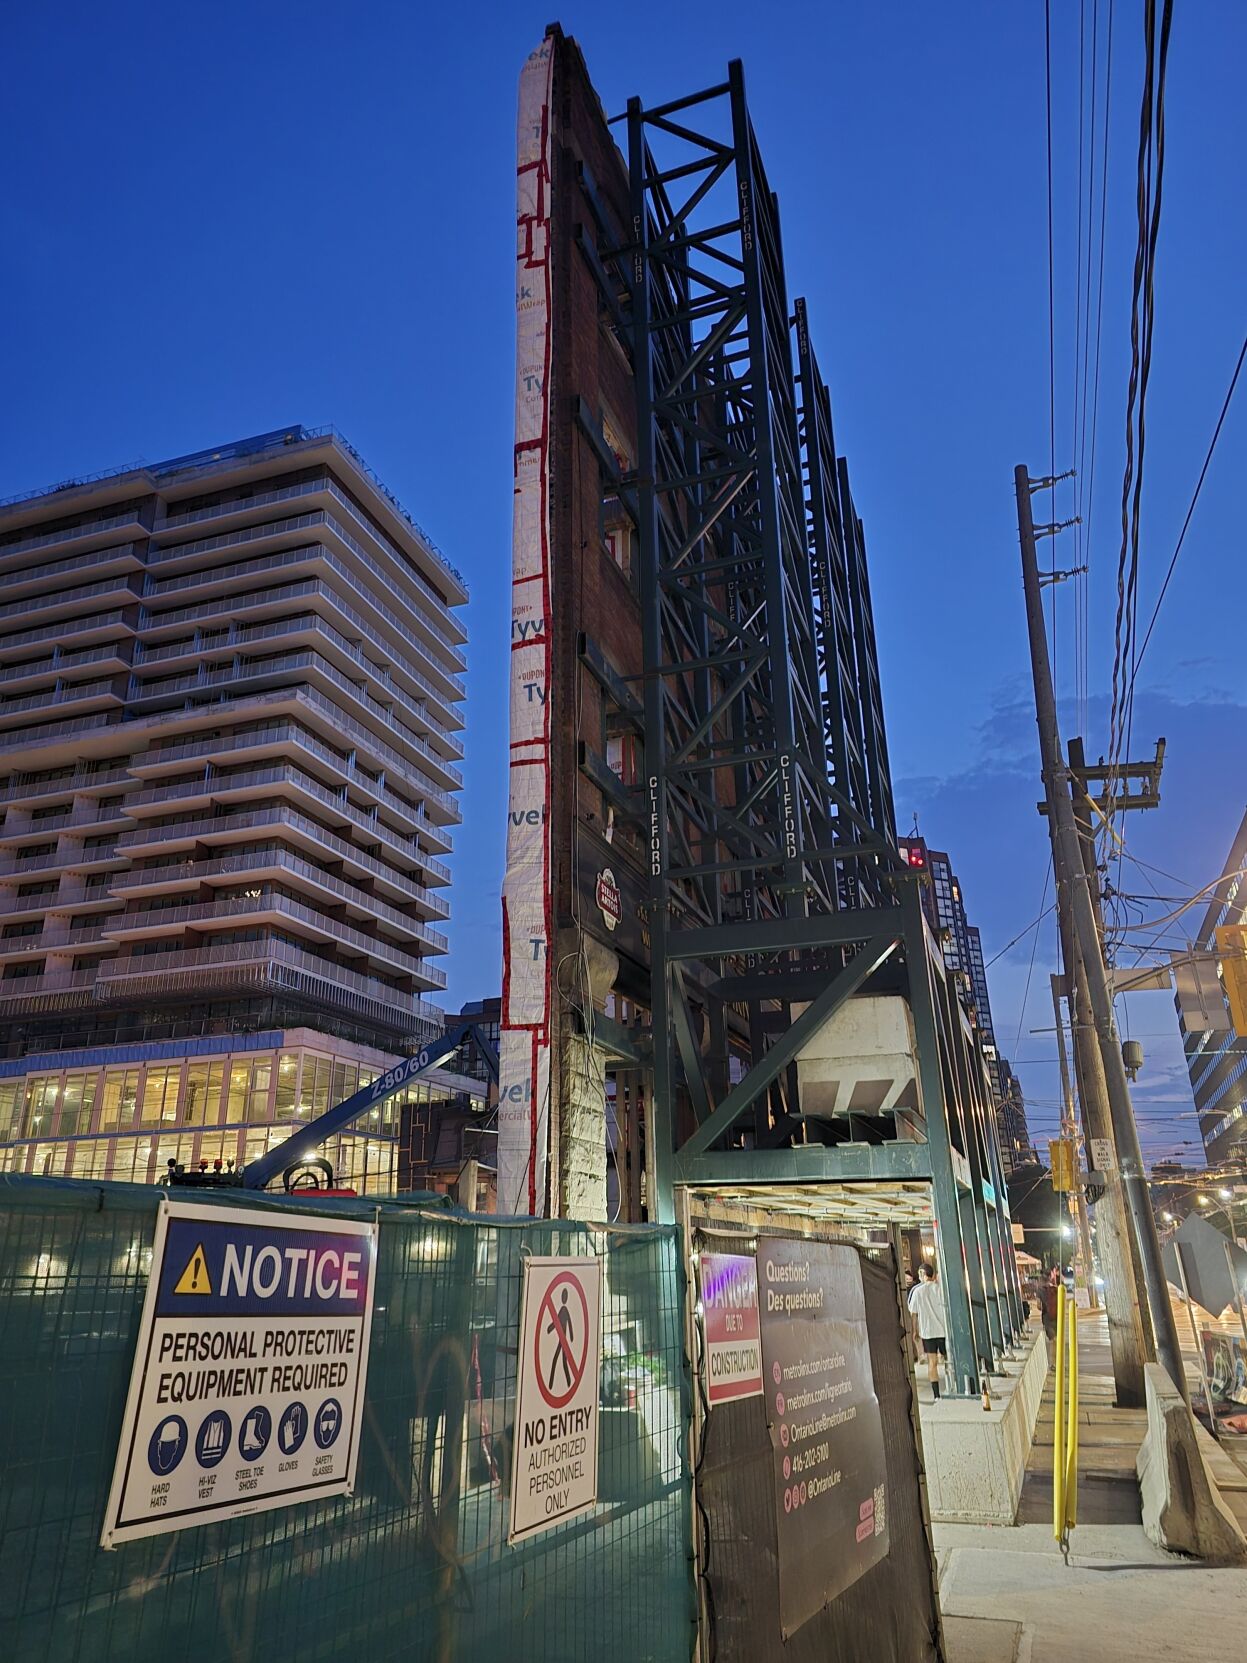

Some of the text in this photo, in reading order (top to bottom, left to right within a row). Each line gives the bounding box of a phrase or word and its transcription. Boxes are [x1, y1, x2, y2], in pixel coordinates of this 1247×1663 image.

[740, 181, 753, 250] CLIFFORD
[633, 215, 642, 283] CLIORD
[819, 561, 831, 628] CLIFFORD
[780, 754, 797, 859] CLIFFORD
[649, 776, 661, 876] CLIFFORD
[601, 882, 618, 904] STELLA
[370, 1051, 429, 1099] Z-80/60
[219, 1243, 362, 1300] NOTICE
[766, 1259, 810, 1283] Questions?
[767, 1287, 824, 1318] Des questions?
[725, 1313, 744, 1332] DUE TO
[158, 1328, 356, 1364] PERSONAL PROTECTIVE
[711, 1347, 759, 1377] CONSTRUCTION
[156, 1361, 349, 1405] EQUIPMENT REQUIRED
[524, 1405, 593, 1449] NO ENTRY
[278, 1460, 298, 1472] GLOVES
[315, 1454, 333, 1466] SAFETY
[528, 1437, 587, 1472] AUTHORIZED
[792, 1441, 829, 1473] 416-202-5100
[198, 1474, 217, 1487] HI-VIZ
[235, 1466, 264, 1481] STEEL TOE
[238, 1479, 258, 1491] SHOES
[312, 1465, 333, 1477] GLASSES
[529, 1460, 584, 1497] PERSONNEL
[807, 1468, 842, 1499] @OntarioLine
[150, 1495, 168, 1508] HATS
[151, 1483, 170, 1496] HARD
[198, 1487, 214, 1499] VEST
[545, 1488, 570, 1515] ONLY
